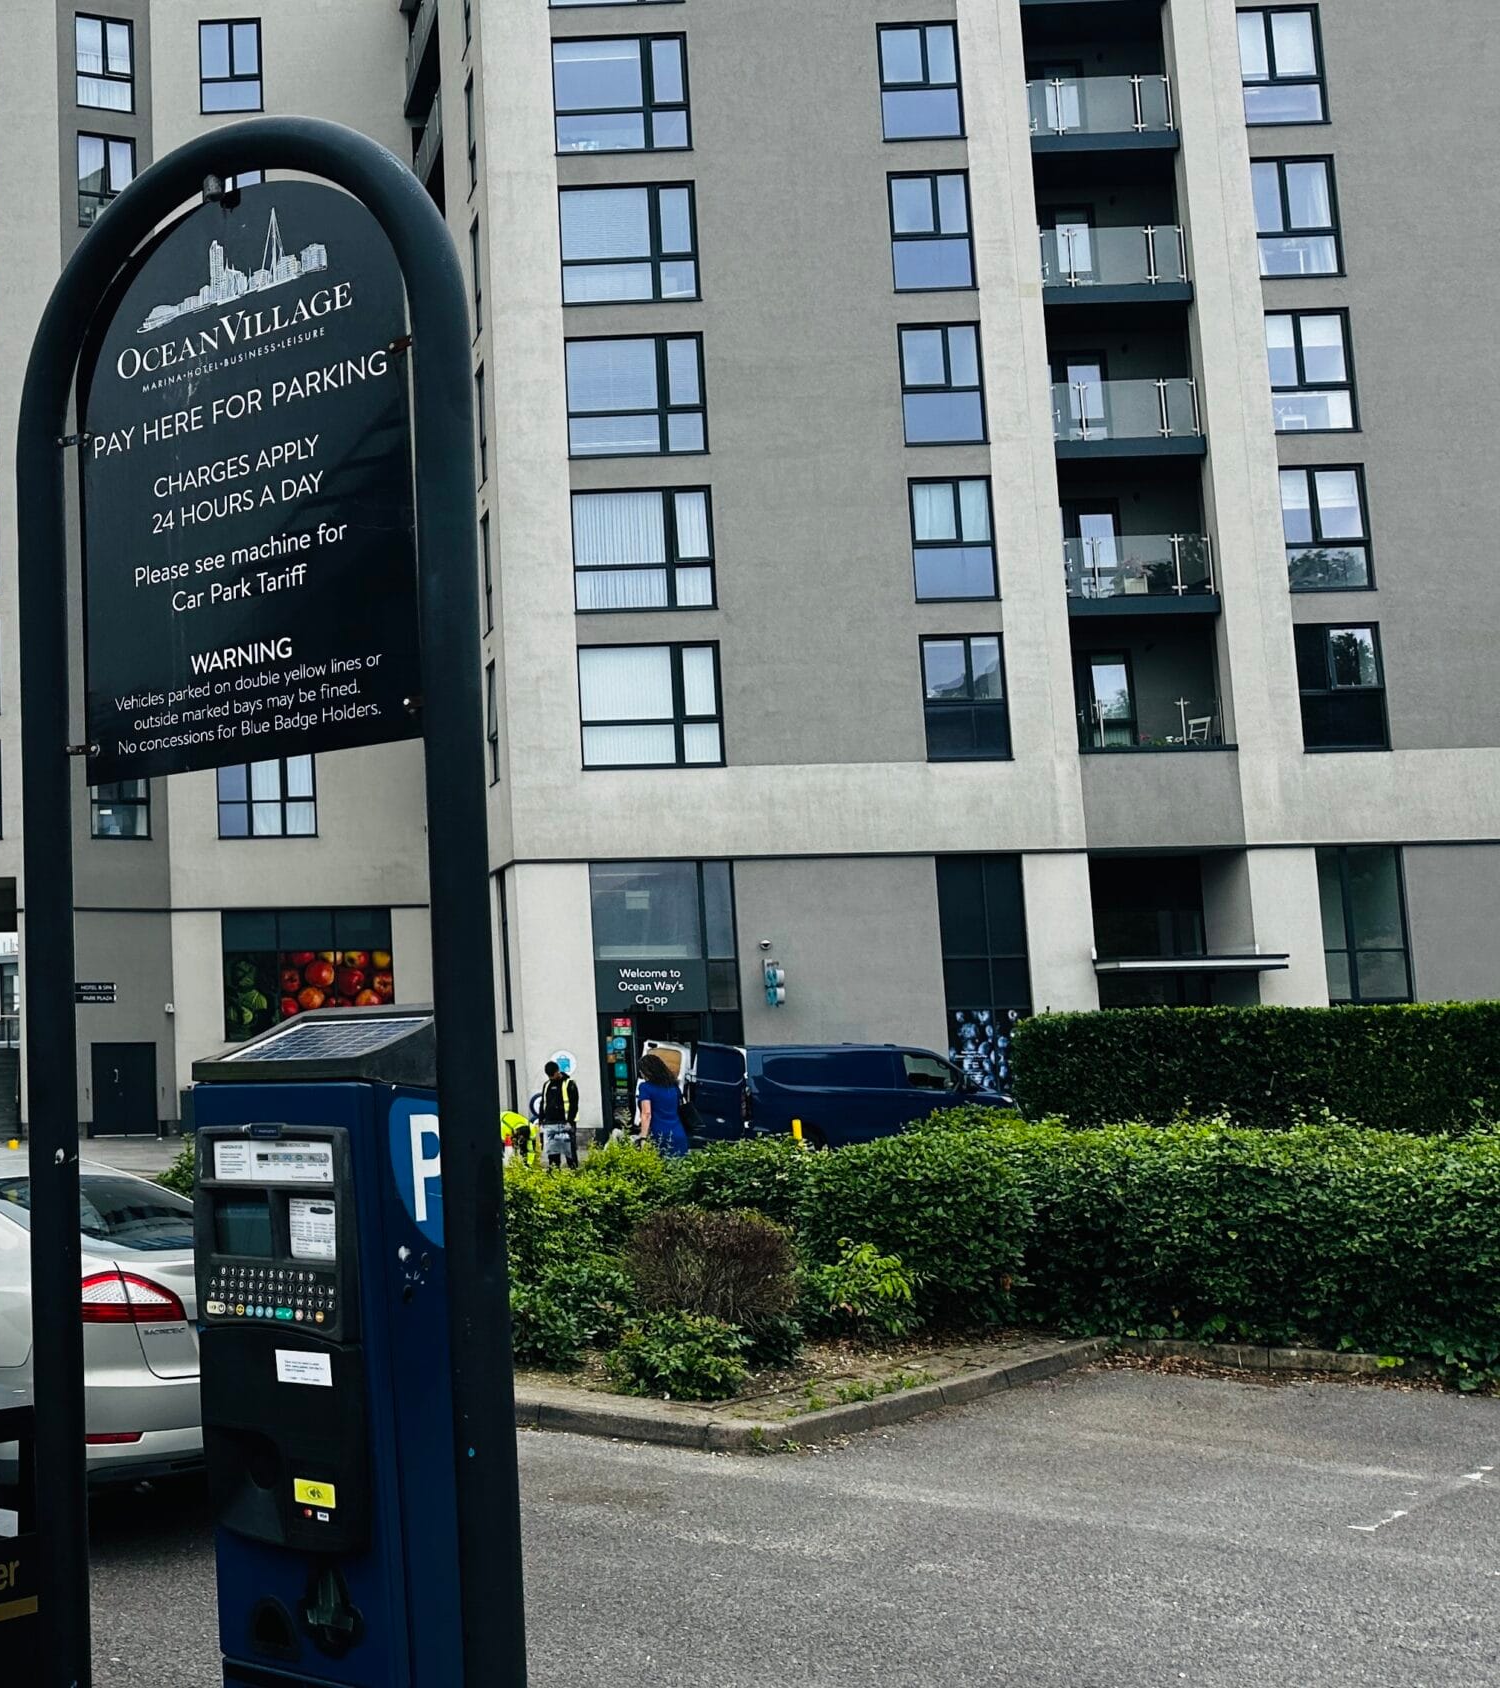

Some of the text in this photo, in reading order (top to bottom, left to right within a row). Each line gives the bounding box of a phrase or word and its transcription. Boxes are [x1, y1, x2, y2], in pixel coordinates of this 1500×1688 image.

[94, 351, 386, 459] PAY HERE FOR PARKING
[154, 434, 319, 497] CHARGES APPLY
[153, 471, 323, 534] 24 HOURS A DAY
[135, 523, 347, 587] Please see machine for
[172, 563, 307, 611] Car Park Tariff
[191, 637, 292, 675] WARNING
[115, 654, 381, 710] Vehicles parked on double yellow lines or
[135, 679, 360, 730] outside marked bays may be fined.
[119, 703, 381, 754] No concessions for Blue Badge Holders.
[618, 981, 684, 993] Ocean Way's
[620, 969, 680, 978] Welcome to
[636, 994, 668, 1006] Co-op
[410, 1114, 441, 1222] P
